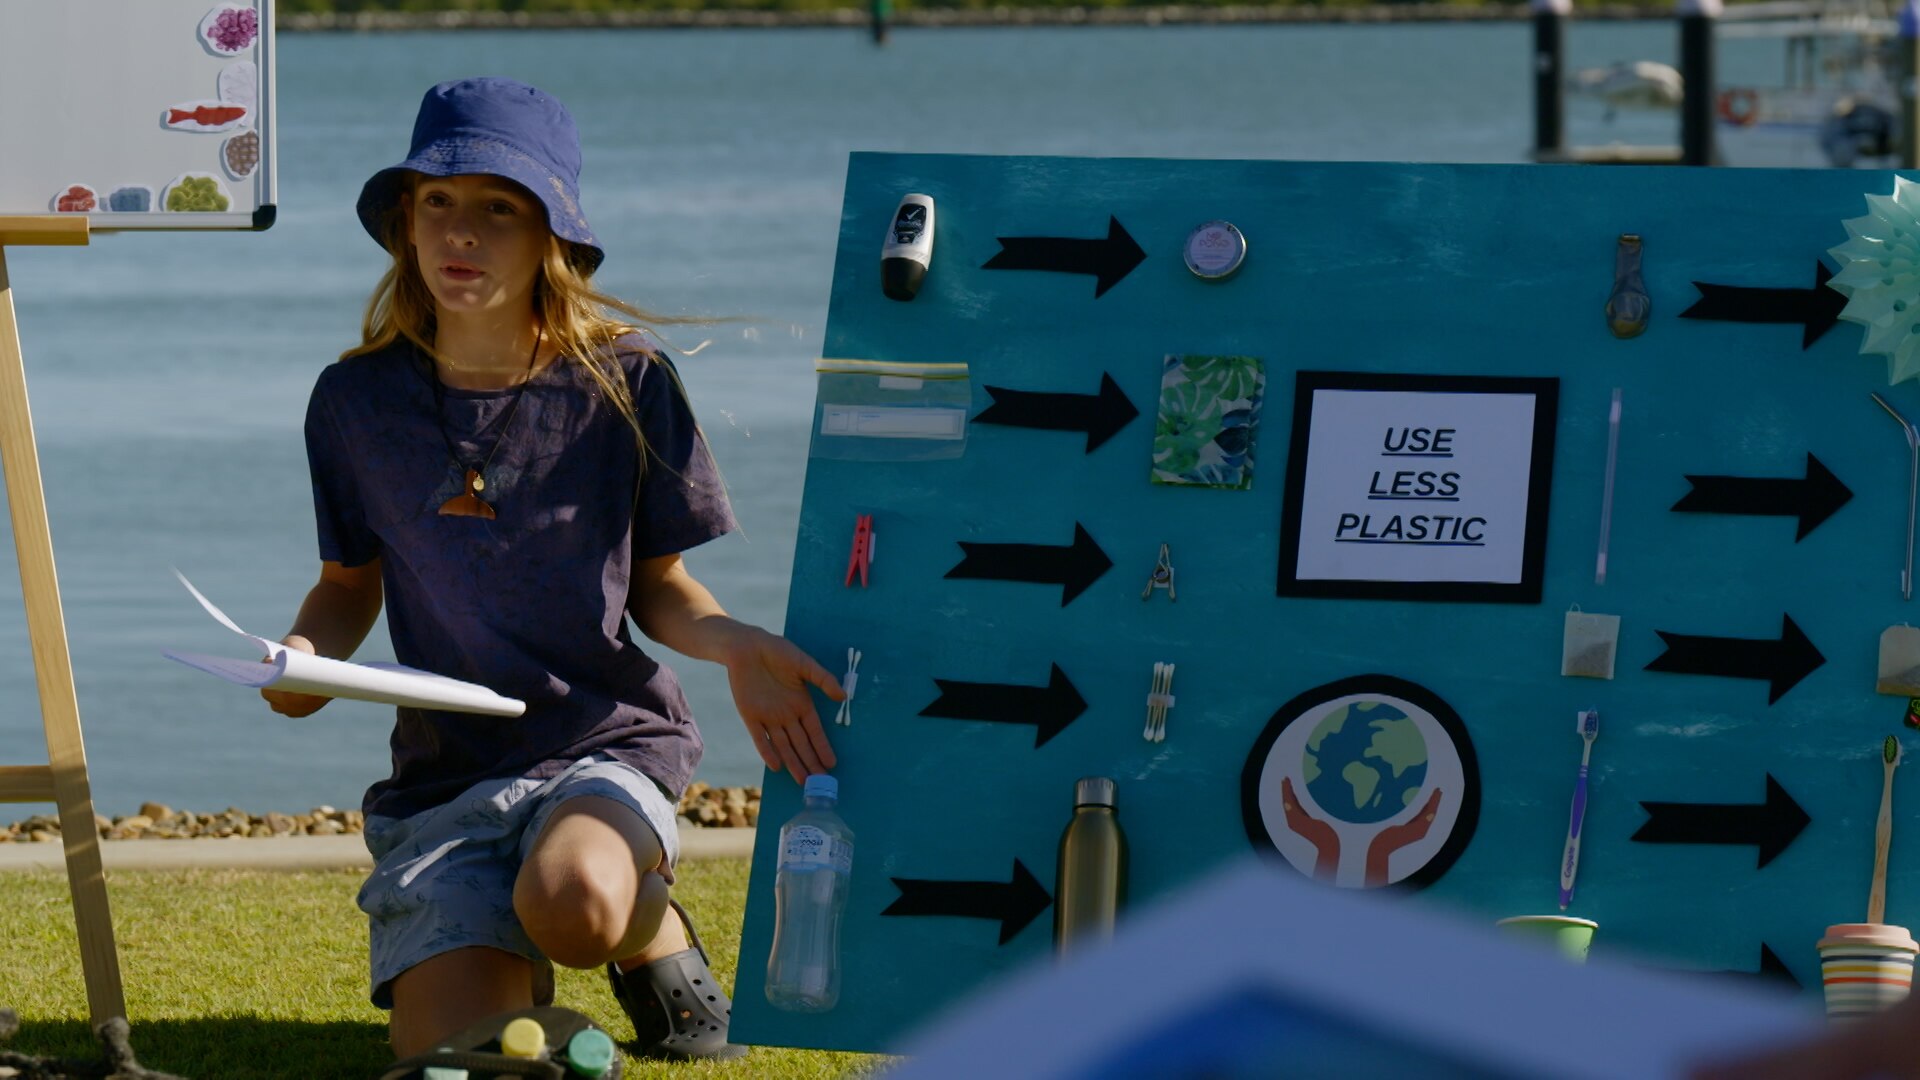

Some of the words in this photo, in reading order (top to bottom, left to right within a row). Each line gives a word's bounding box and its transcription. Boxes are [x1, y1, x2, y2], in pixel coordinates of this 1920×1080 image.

[1383, 427, 1456, 454] USE
[1368, 471, 1460, 498] LESS
[1335, 513, 1487, 543] PLASTIC
